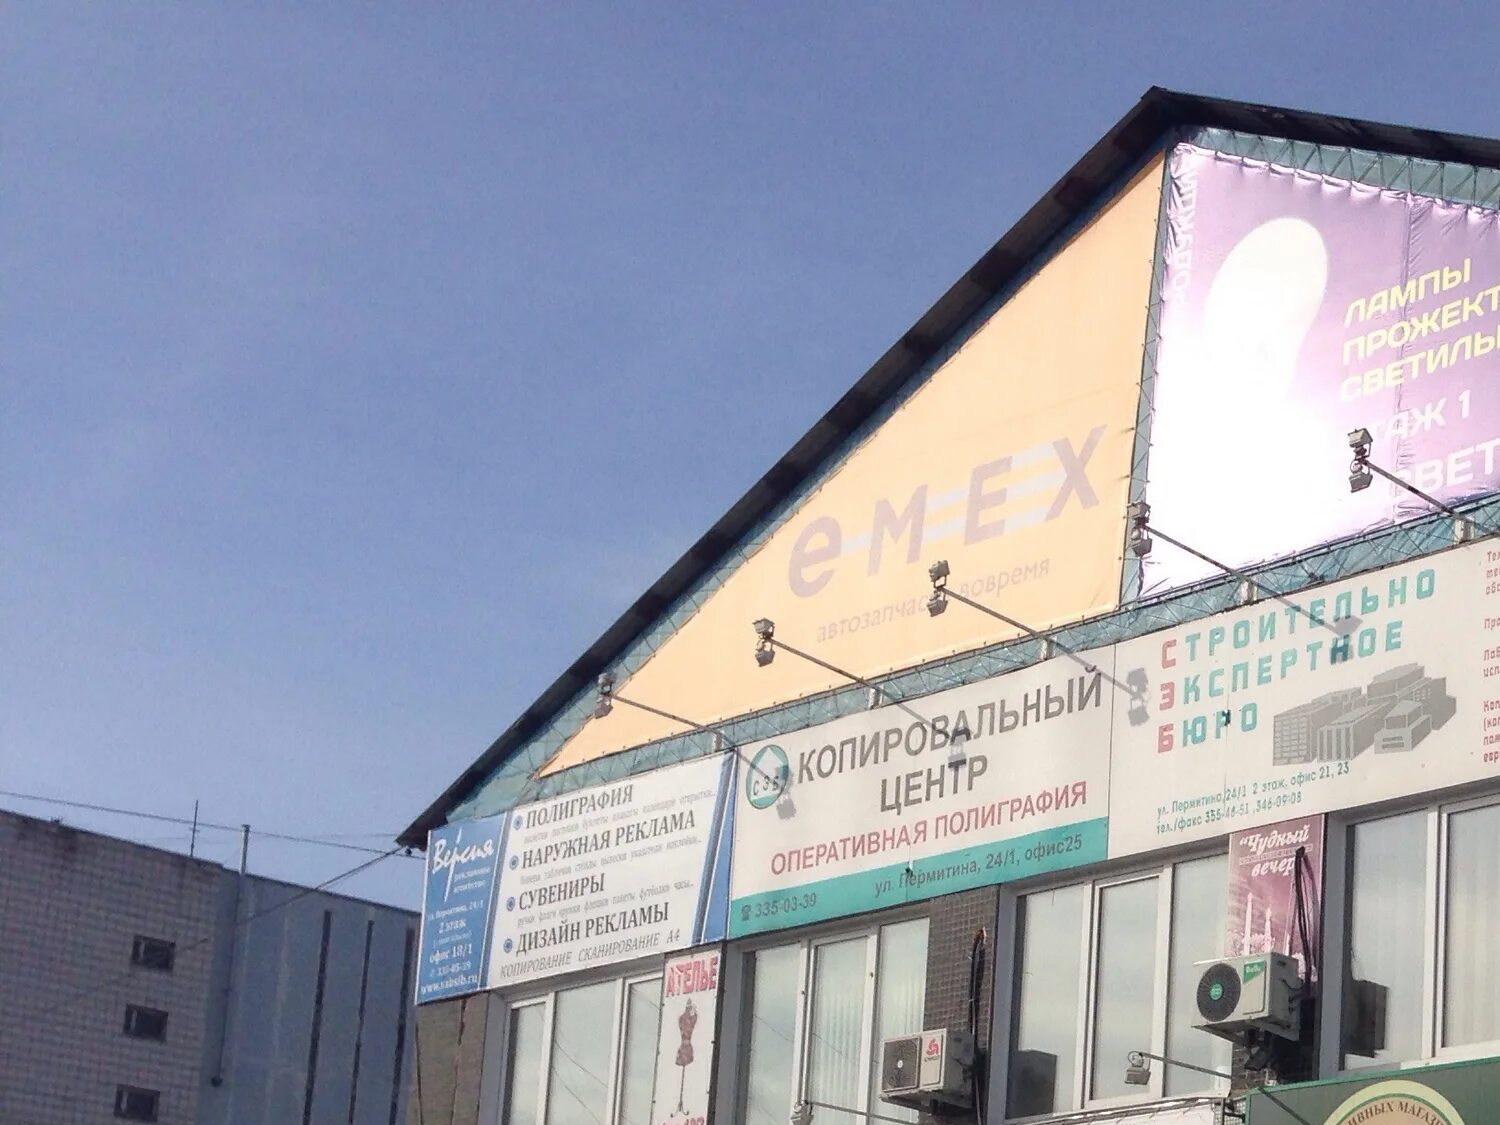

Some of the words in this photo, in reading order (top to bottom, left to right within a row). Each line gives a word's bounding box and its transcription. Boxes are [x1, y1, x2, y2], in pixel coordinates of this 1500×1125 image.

[1344, 258, 1471, 328] ЛАМПЫ
[1458, 389, 1471, 419] 1
[959, 559, 1050, 602] вовремя
[1160, 569, 1437, 670] СТРОИТЕЛЬНО
[1158, 621, 1404, 711] ЭКСПЕРТНОЕ
[797, 666, 1102, 783] КОПИРОВАЛЬНЫЙ
[1157, 702, 1260, 754] БЮРО
[880, 754, 987, 815] ЦЕНТР
[1290, 772, 1316, 788] офис
[1337, 761, 1351, 775] 23
[525, 784, 635, 829] ПОЛИГРАФИЯ
[770, 820, 927, 876] ОПЕРАТИВНАЯ
[935, 780, 1087, 839] ПОЛИГРАФИЯ
[522, 830, 611, 870] НАРУЖНАЯ
[615, 809, 696, 847] РЕКЛАМА
[519, 872, 605, 911] СУВЕНИРЫ
[875, 880, 892, 897] ул.
[985, 849, 1020, 871] 24/1,
[515, 918, 581, 957] ДИЗАЙН
[585, 902, 670, 936] РЕКЛАМЫ
[754, 893, 817, 918] 335-03-39
[500, 951, 572, 978] КОПИРОВАНИЕ
[578, 932, 661, 962] СКАНИРОВАНИЕ
[666, 957, 719, 997] АТЕЛЬЕ
